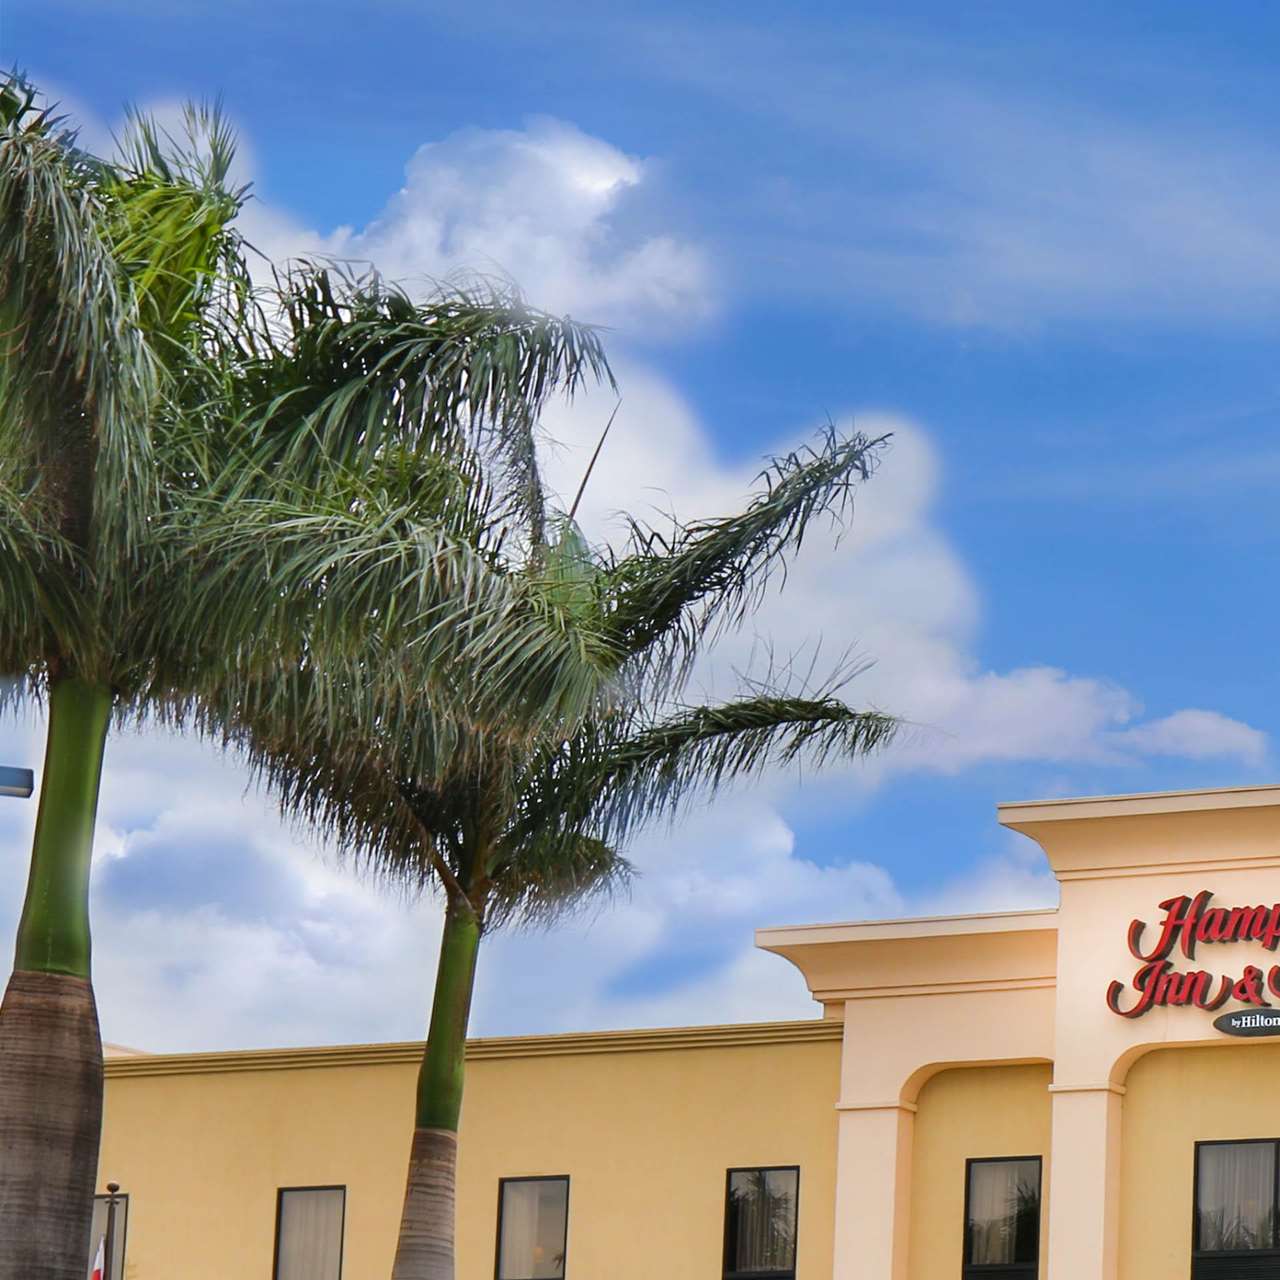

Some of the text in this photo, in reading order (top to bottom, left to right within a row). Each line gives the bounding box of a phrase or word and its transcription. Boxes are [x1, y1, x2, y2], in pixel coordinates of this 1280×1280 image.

[1106, 959, 1233, 1019] Inn
[1232, 965, 1272, 1008] &
[1231, 1018, 1241, 1029] by
